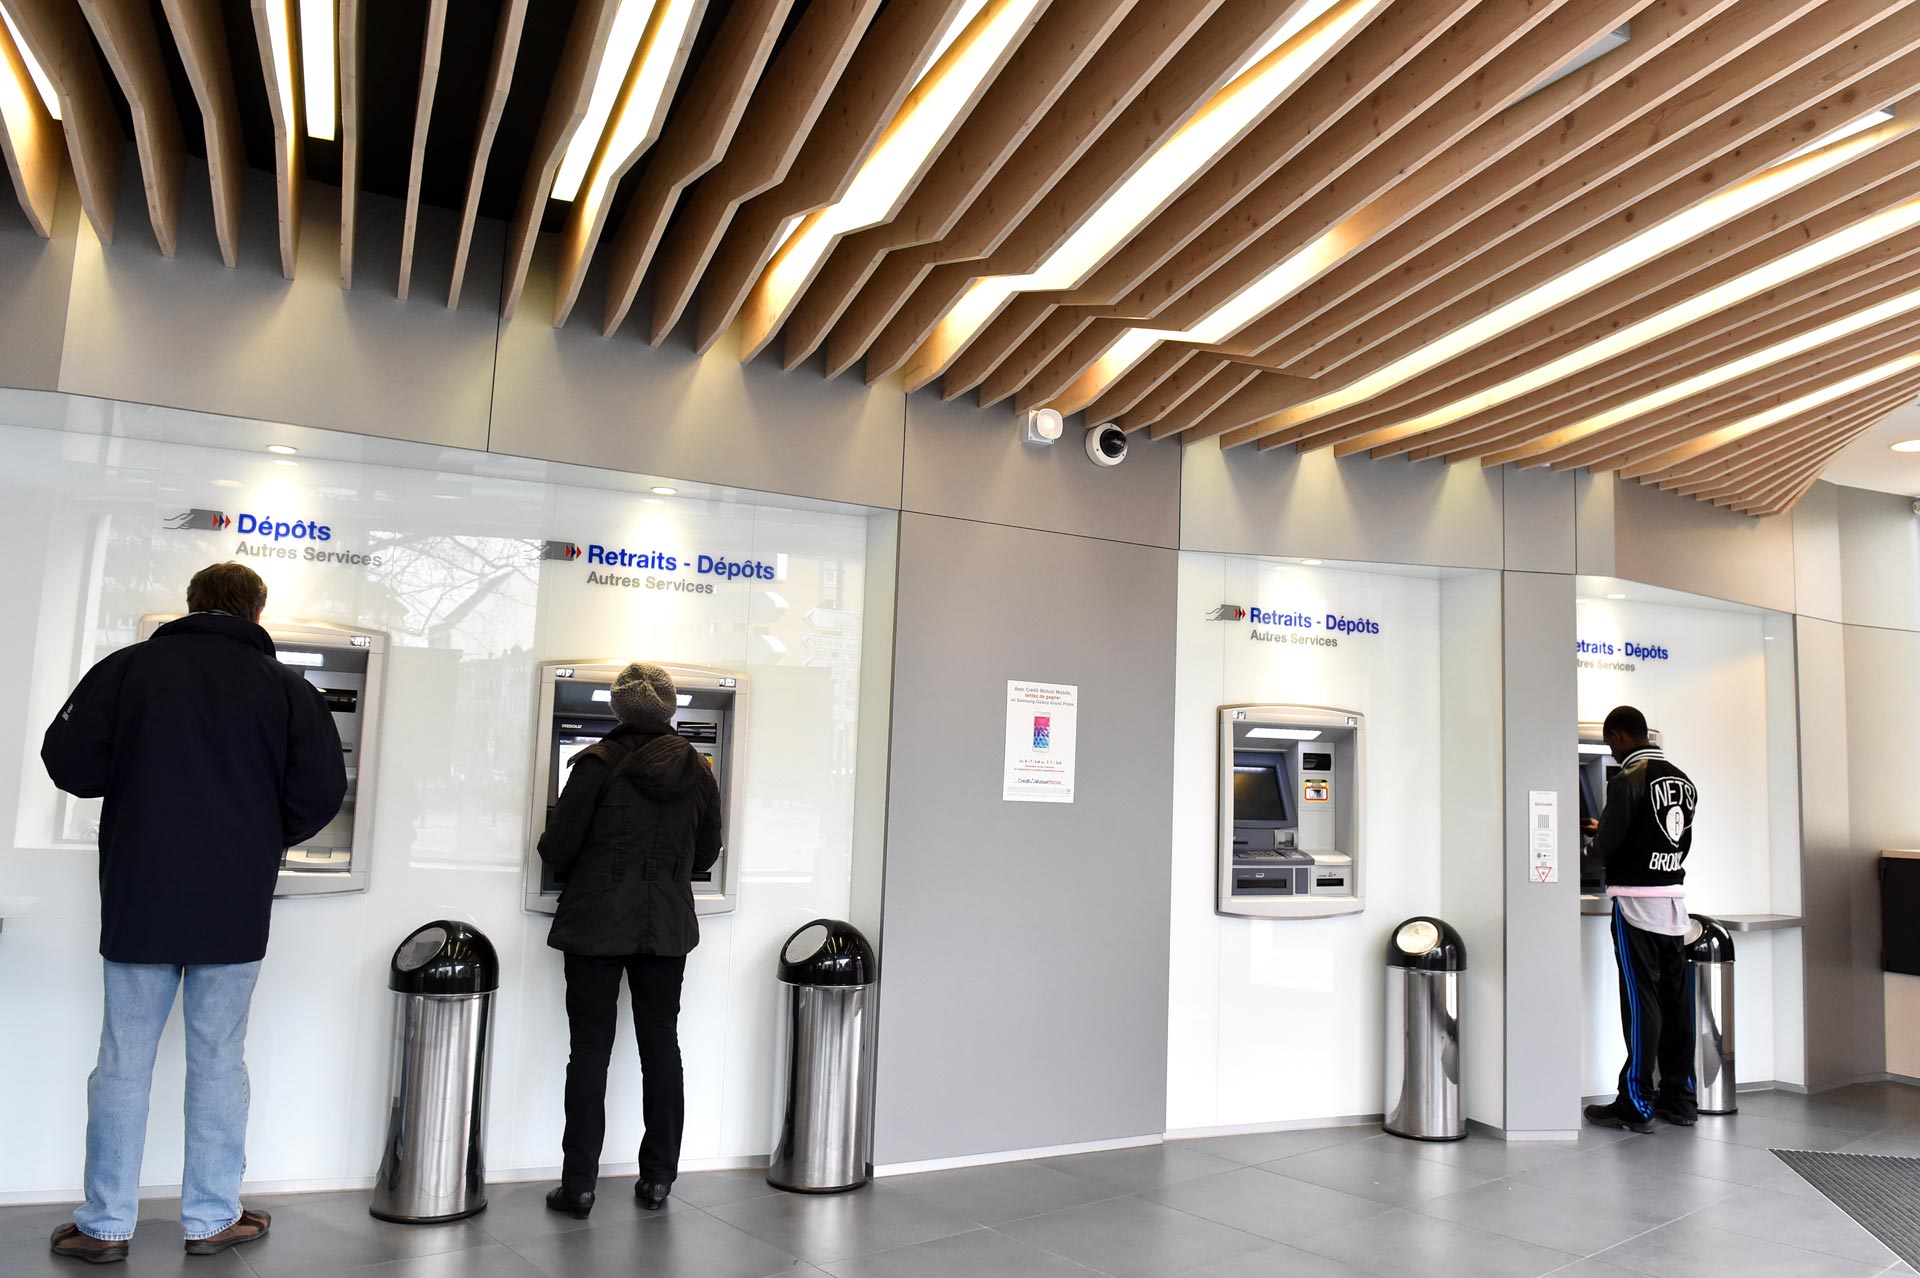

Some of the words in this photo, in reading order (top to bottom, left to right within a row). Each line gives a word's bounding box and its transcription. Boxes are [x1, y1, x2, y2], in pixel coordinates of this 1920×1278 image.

[237, 513, 332, 541] Dépôts
[235, 541, 297, 559] Autres
[303, 546, 382, 567] Services
[588, 544, 677, 571] Retraits
[697, 554, 775, 580] Dépôts
[587, 571, 640, 588] Autres
[645, 575, 714, 594] Services
[1250, 607, 1312, 628] Retraits
[1326, 614, 1379, 635] Dépôts
[1250, 629, 1287, 643] Autres
[1290, 633, 1338, 647] Services
[1576, 639, 1614, 655] etraits
[1625, 642, 1669, 660] Dépôts
[1577, 659, 1594, 668] tres
[1597, 660, 1635, 671] Services
[1654, 780, 1693, 810] NETS
